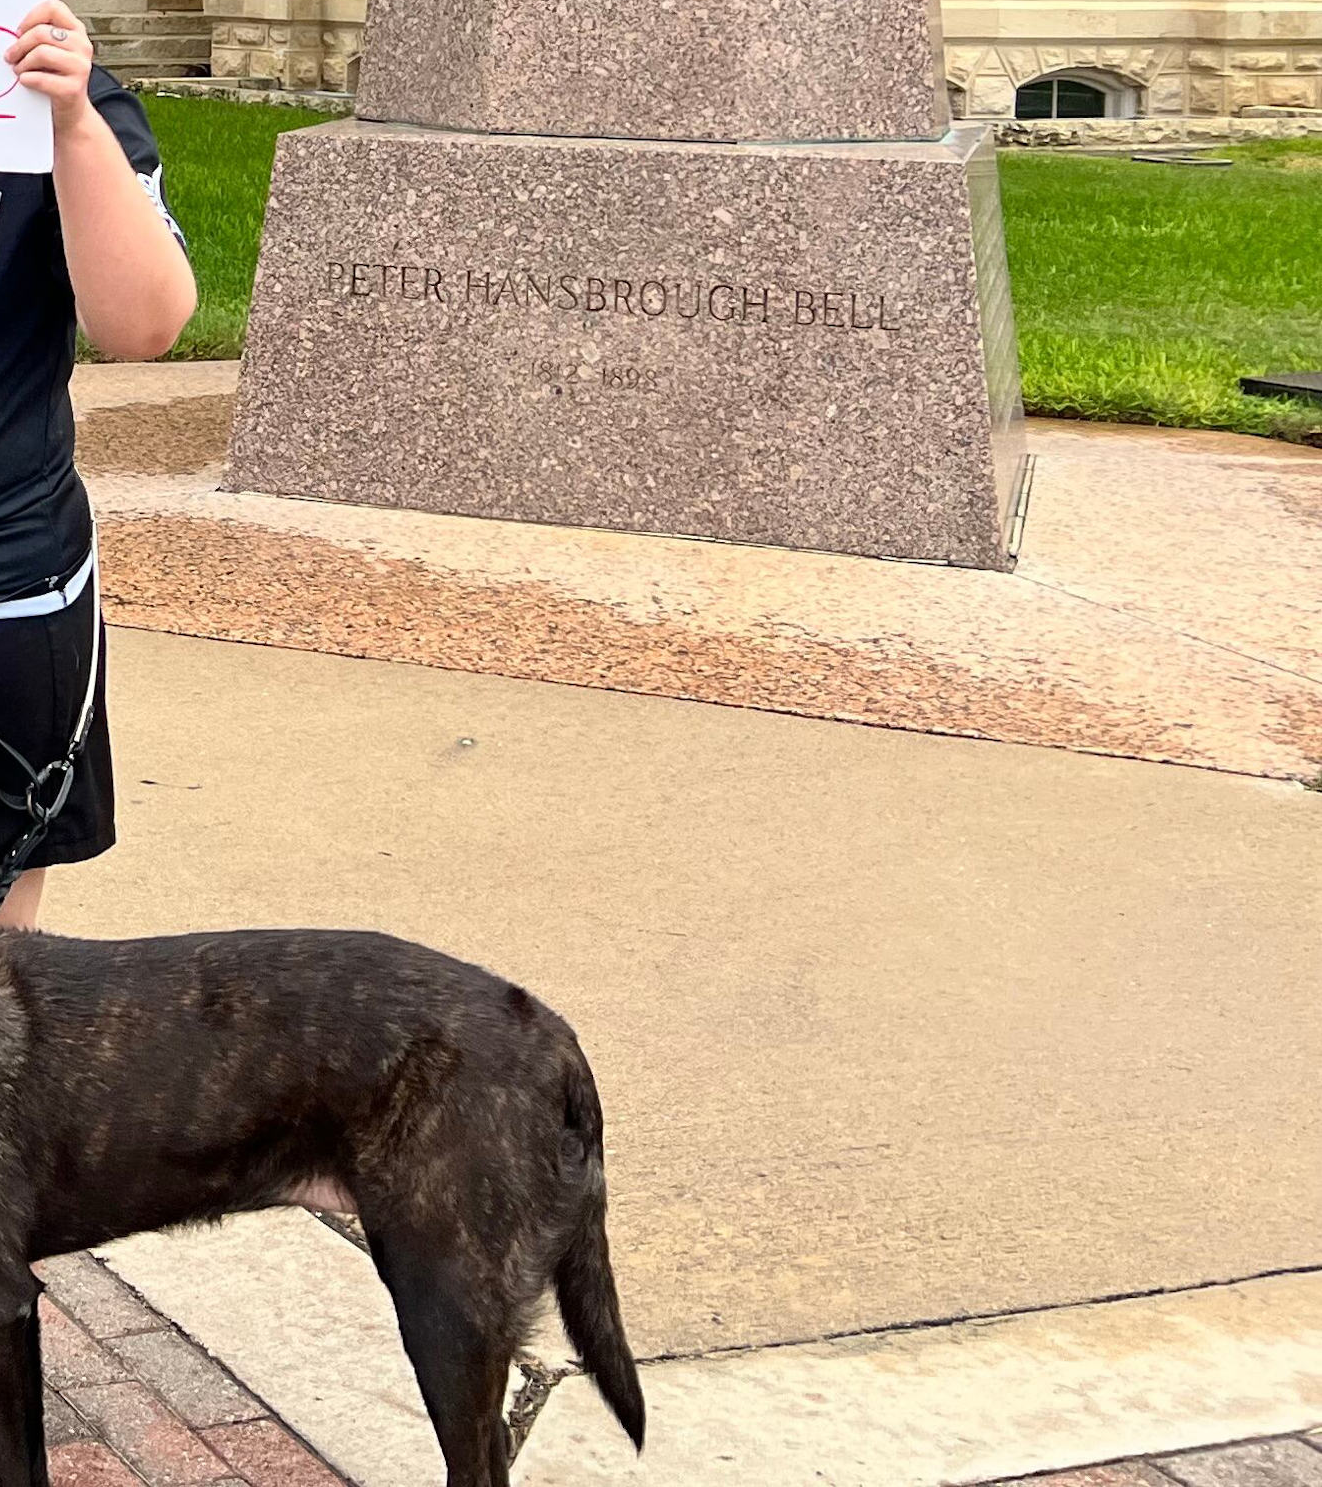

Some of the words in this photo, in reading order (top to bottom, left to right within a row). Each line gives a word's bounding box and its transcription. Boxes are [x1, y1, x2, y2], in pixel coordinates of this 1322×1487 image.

[328, 263, 445, 303] PETER
[463, 269, 768, 323] HANSBROUGH
[794, 290, 902, 331] BELL
